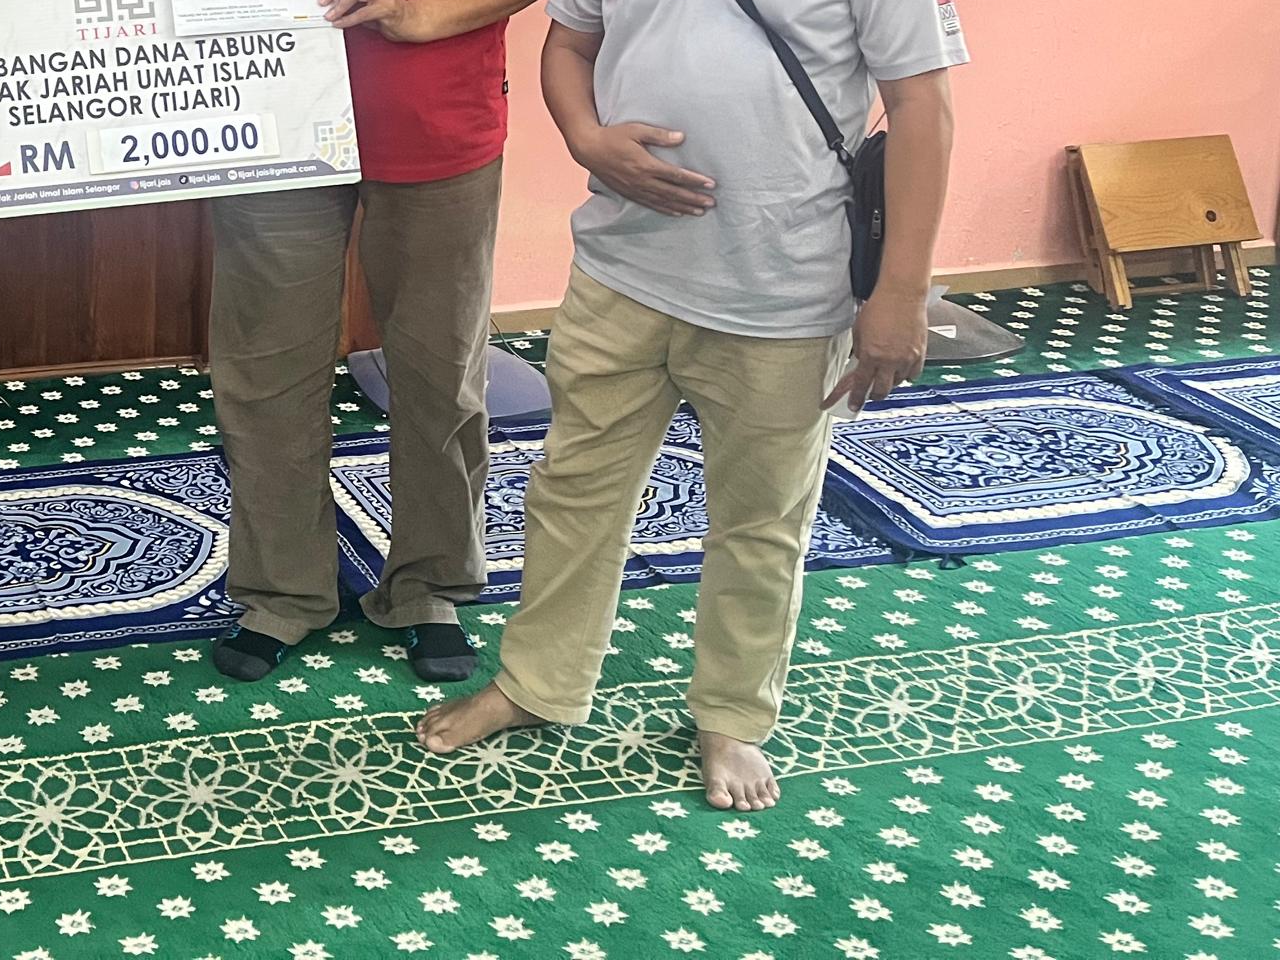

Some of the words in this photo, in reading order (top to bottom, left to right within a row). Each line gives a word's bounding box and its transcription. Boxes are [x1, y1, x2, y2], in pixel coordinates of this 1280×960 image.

[76, 22, 157, 40] TIJARI
[115, 41, 189, 67] DANA
[194, 32, 296, 60] TABUNG
[39, 71, 128, 99] JARIAH
[137, 64, 205, 90] UMAT
[213, 57, 286, 82] ISLAM
[8, 95, 143, 127] SELANGOR
[151, 85, 241, 119] (TIJARI)
[20, 140, 75, 174] RM
[121, 122, 259, 166] 2,000.00
[14, 191, 38, 202] Jariah
[39, 188, 61, 198] Umat
[62, 186, 84, 196] Islam
[85, 183, 121, 195] Selangor
